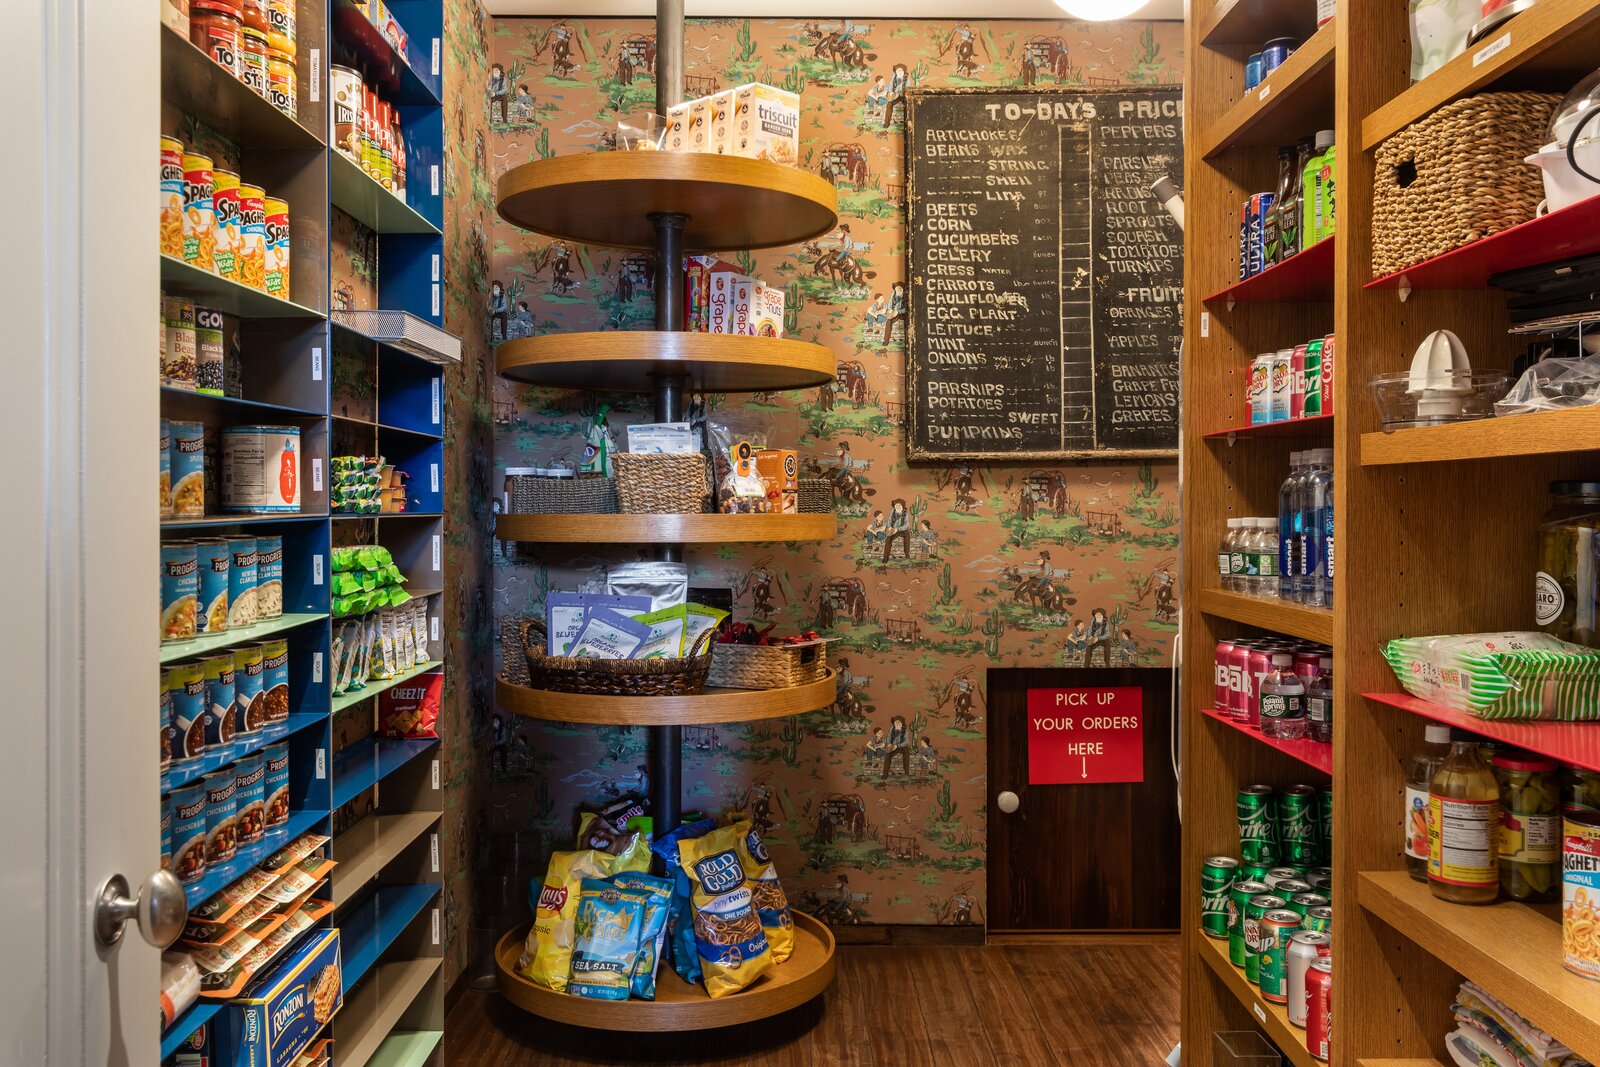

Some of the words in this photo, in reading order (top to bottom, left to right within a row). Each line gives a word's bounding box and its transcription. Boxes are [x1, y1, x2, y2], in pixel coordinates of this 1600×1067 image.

[758, 104, 798, 128] triscuit
[926, 129, 1019, 142] ARTICHOKES
[1100, 125, 1177, 139] PEPPERS
[926, 144, 980, 157] BEANS
[990, 160, 1050, 171] STRING
[1105, 186, 1158, 199] RADIS
[926, 203, 978, 216] BEETS
[1106, 200, 1147, 214] ROOT
[1106, 214, 1175, 229] SPROUTS
[1283, 210, 1295, 220] PURE
[927, 217, 973, 231] CORN
[1264, 225, 1276, 235] PURE
[1283, 218, 1295, 229] LEAF
[927, 233, 1020, 247] CUCUMBERS
[1106, 230, 1168, 245] SQUASH
[1264, 233, 1276, 243] LEAF
[1250, 219, 1260, 272] ULTRA
[927, 248, 992, 262] CELERY
[927, 264, 975, 277] CRESS
[1107, 259, 1174, 273] TURNIPS
[926, 278, 995, 291] CARROTS
[927, 307, 962, 320] EGG
[969, 308, 1017, 320] PLANT
[1110, 307, 1173, 318] ORANGES
[927, 323, 994, 336] LETTUCE
[927, 338, 966, 350] MINT
[1110, 334, 1159, 347] APPLES
[928, 352, 987, 365] ONIONS
[1322, 345, 1333, 384] Coke
[1112, 364, 1179, 377] BANANAS
[928, 381, 1005, 396] PARSNIPS
[1113, 380, 1158, 392] GRAPE
[928, 396, 1003, 410] POTATOES
[1114, 393, 1177, 407] LEMONS
[1008, 411, 1059, 425] SWEET
[1112, 409, 1171, 422] GRAPES
[928, 425, 1023, 439] PUMPKINS
[1056, 693, 1088, 706] PICK
[1097, 692, 1115, 705] UP
[1263, 696, 1285, 706] Poland
[1263, 702, 1285, 713] Spring
[1033, 718, 1074, 730] YOUR
[1081, 716, 1138, 730] ORDERS
[1068, 742, 1104, 756] HERE
[1443, 802, 1472, 810] Nutrition
[701, 853, 735, 877] ROLD
[704, 863, 743, 891] GOLD
[1565, 873, 1593, 886] ORIGINAL
[728, 890, 750, 904] twists
[724, 911, 737, 919] ONE
[575, 961, 592, 970] SEA
[593, 962, 618, 971] SALT
